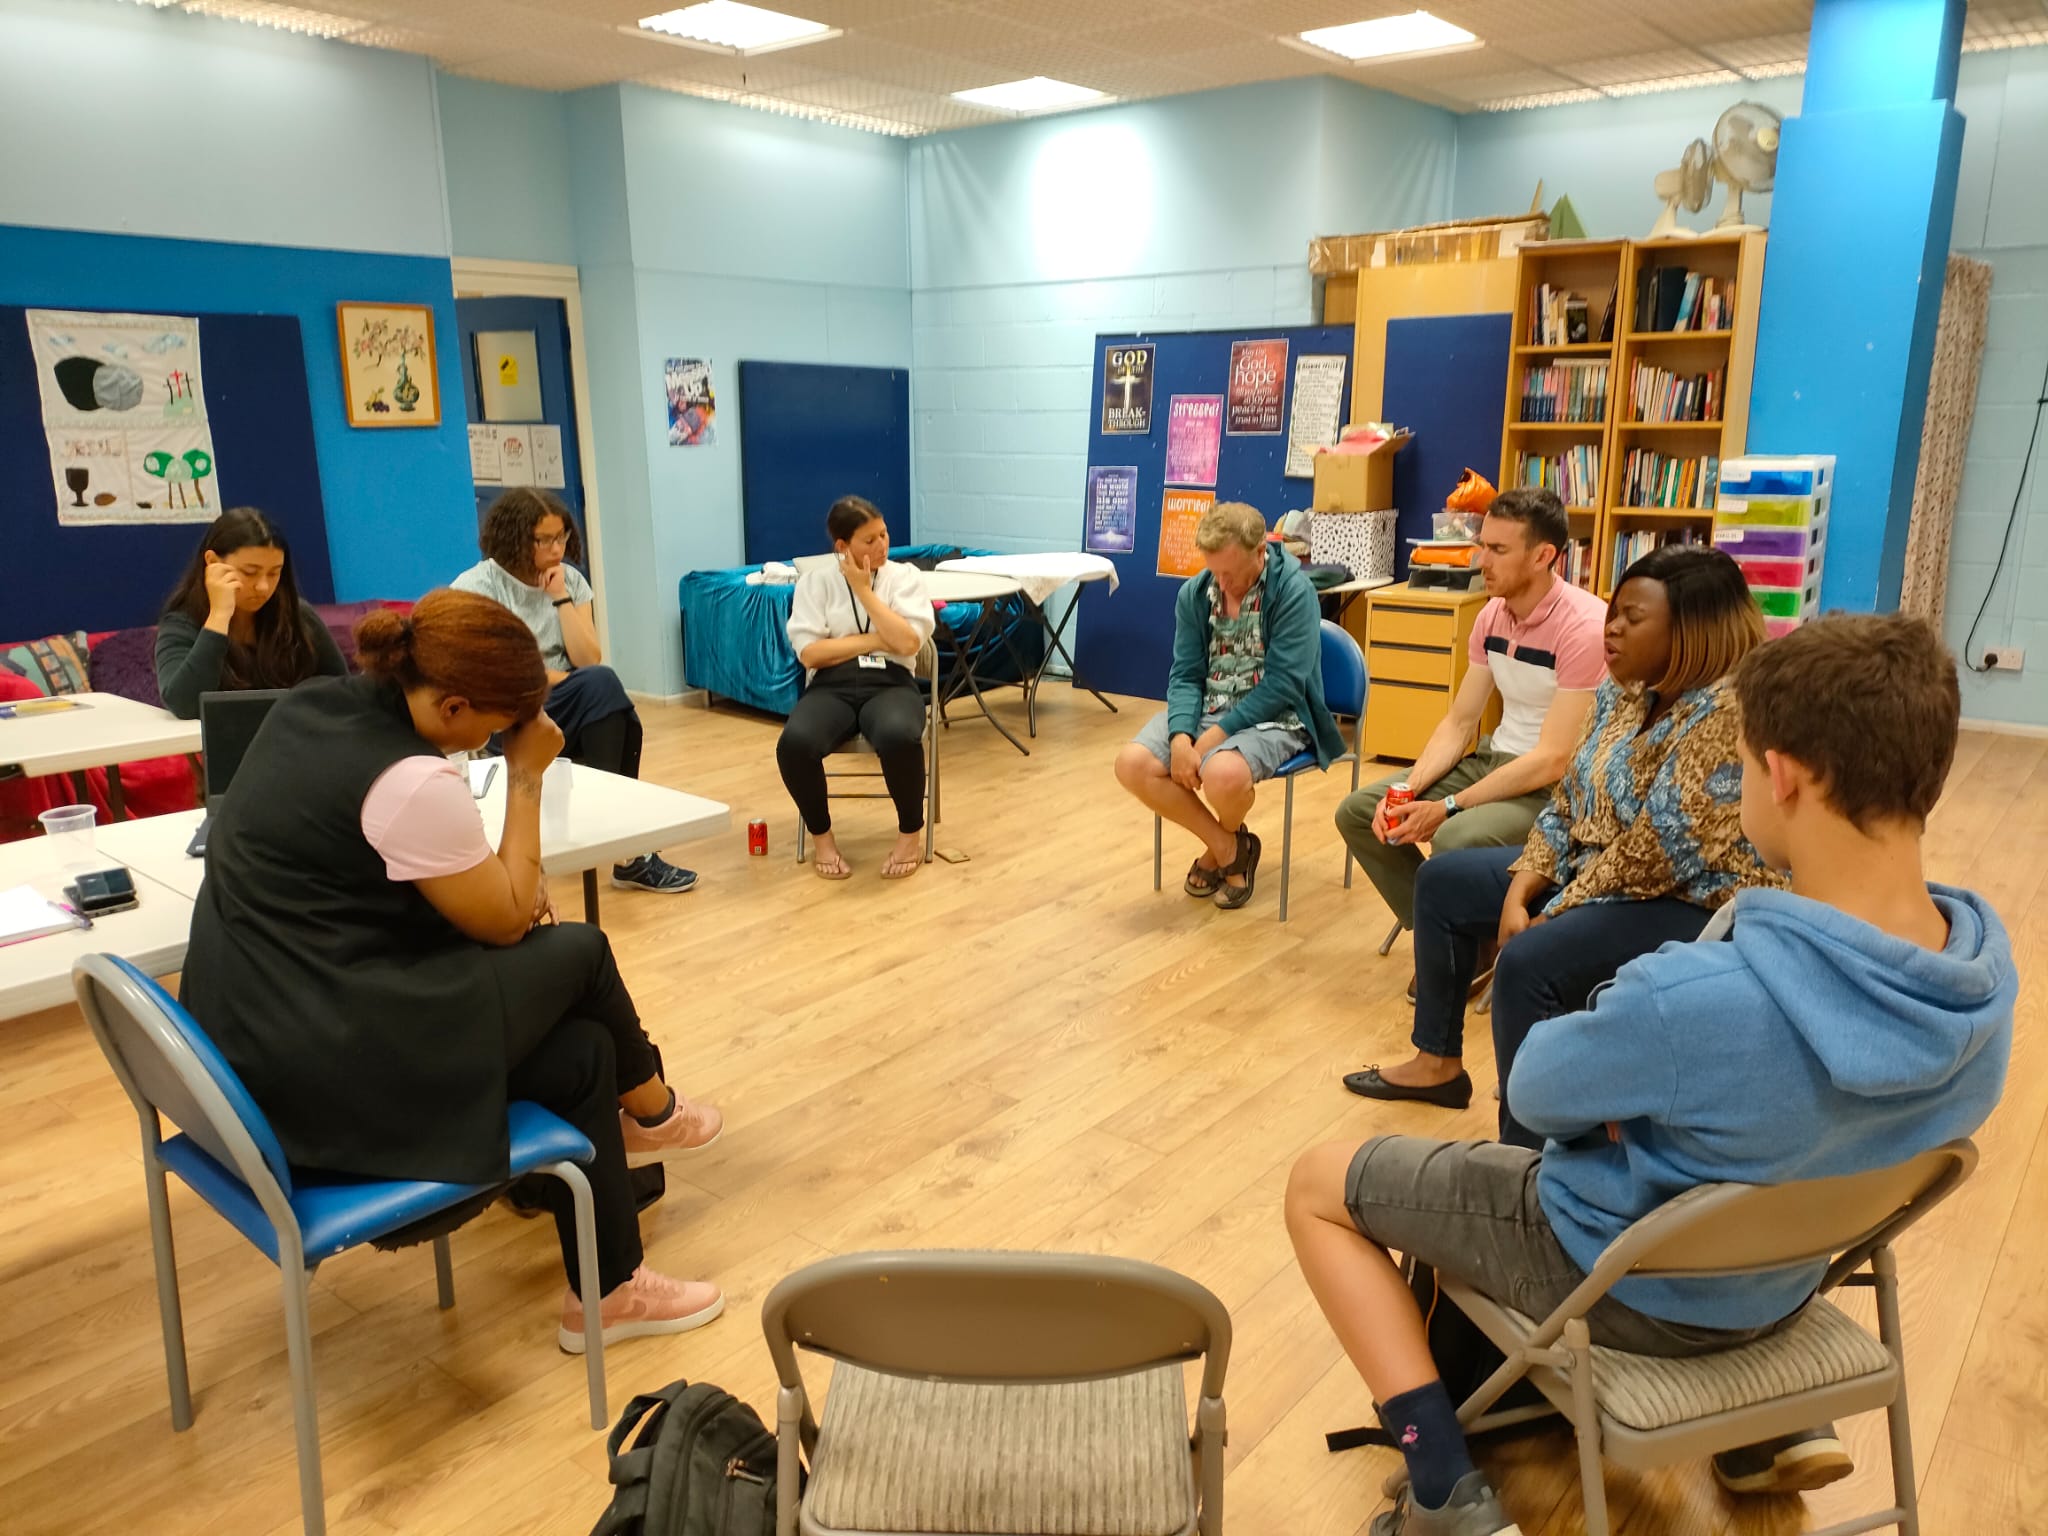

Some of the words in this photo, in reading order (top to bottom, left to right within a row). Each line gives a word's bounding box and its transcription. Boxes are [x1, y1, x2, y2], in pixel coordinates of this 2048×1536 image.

[1112, 350, 1147, 367] GOD
[1240, 354, 1267, 370] God
[1235, 365, 1277, 389] hope
[1108, 407, 1147, 420] BREAK-
[1107, 419, 1147, 429] THROUGH
